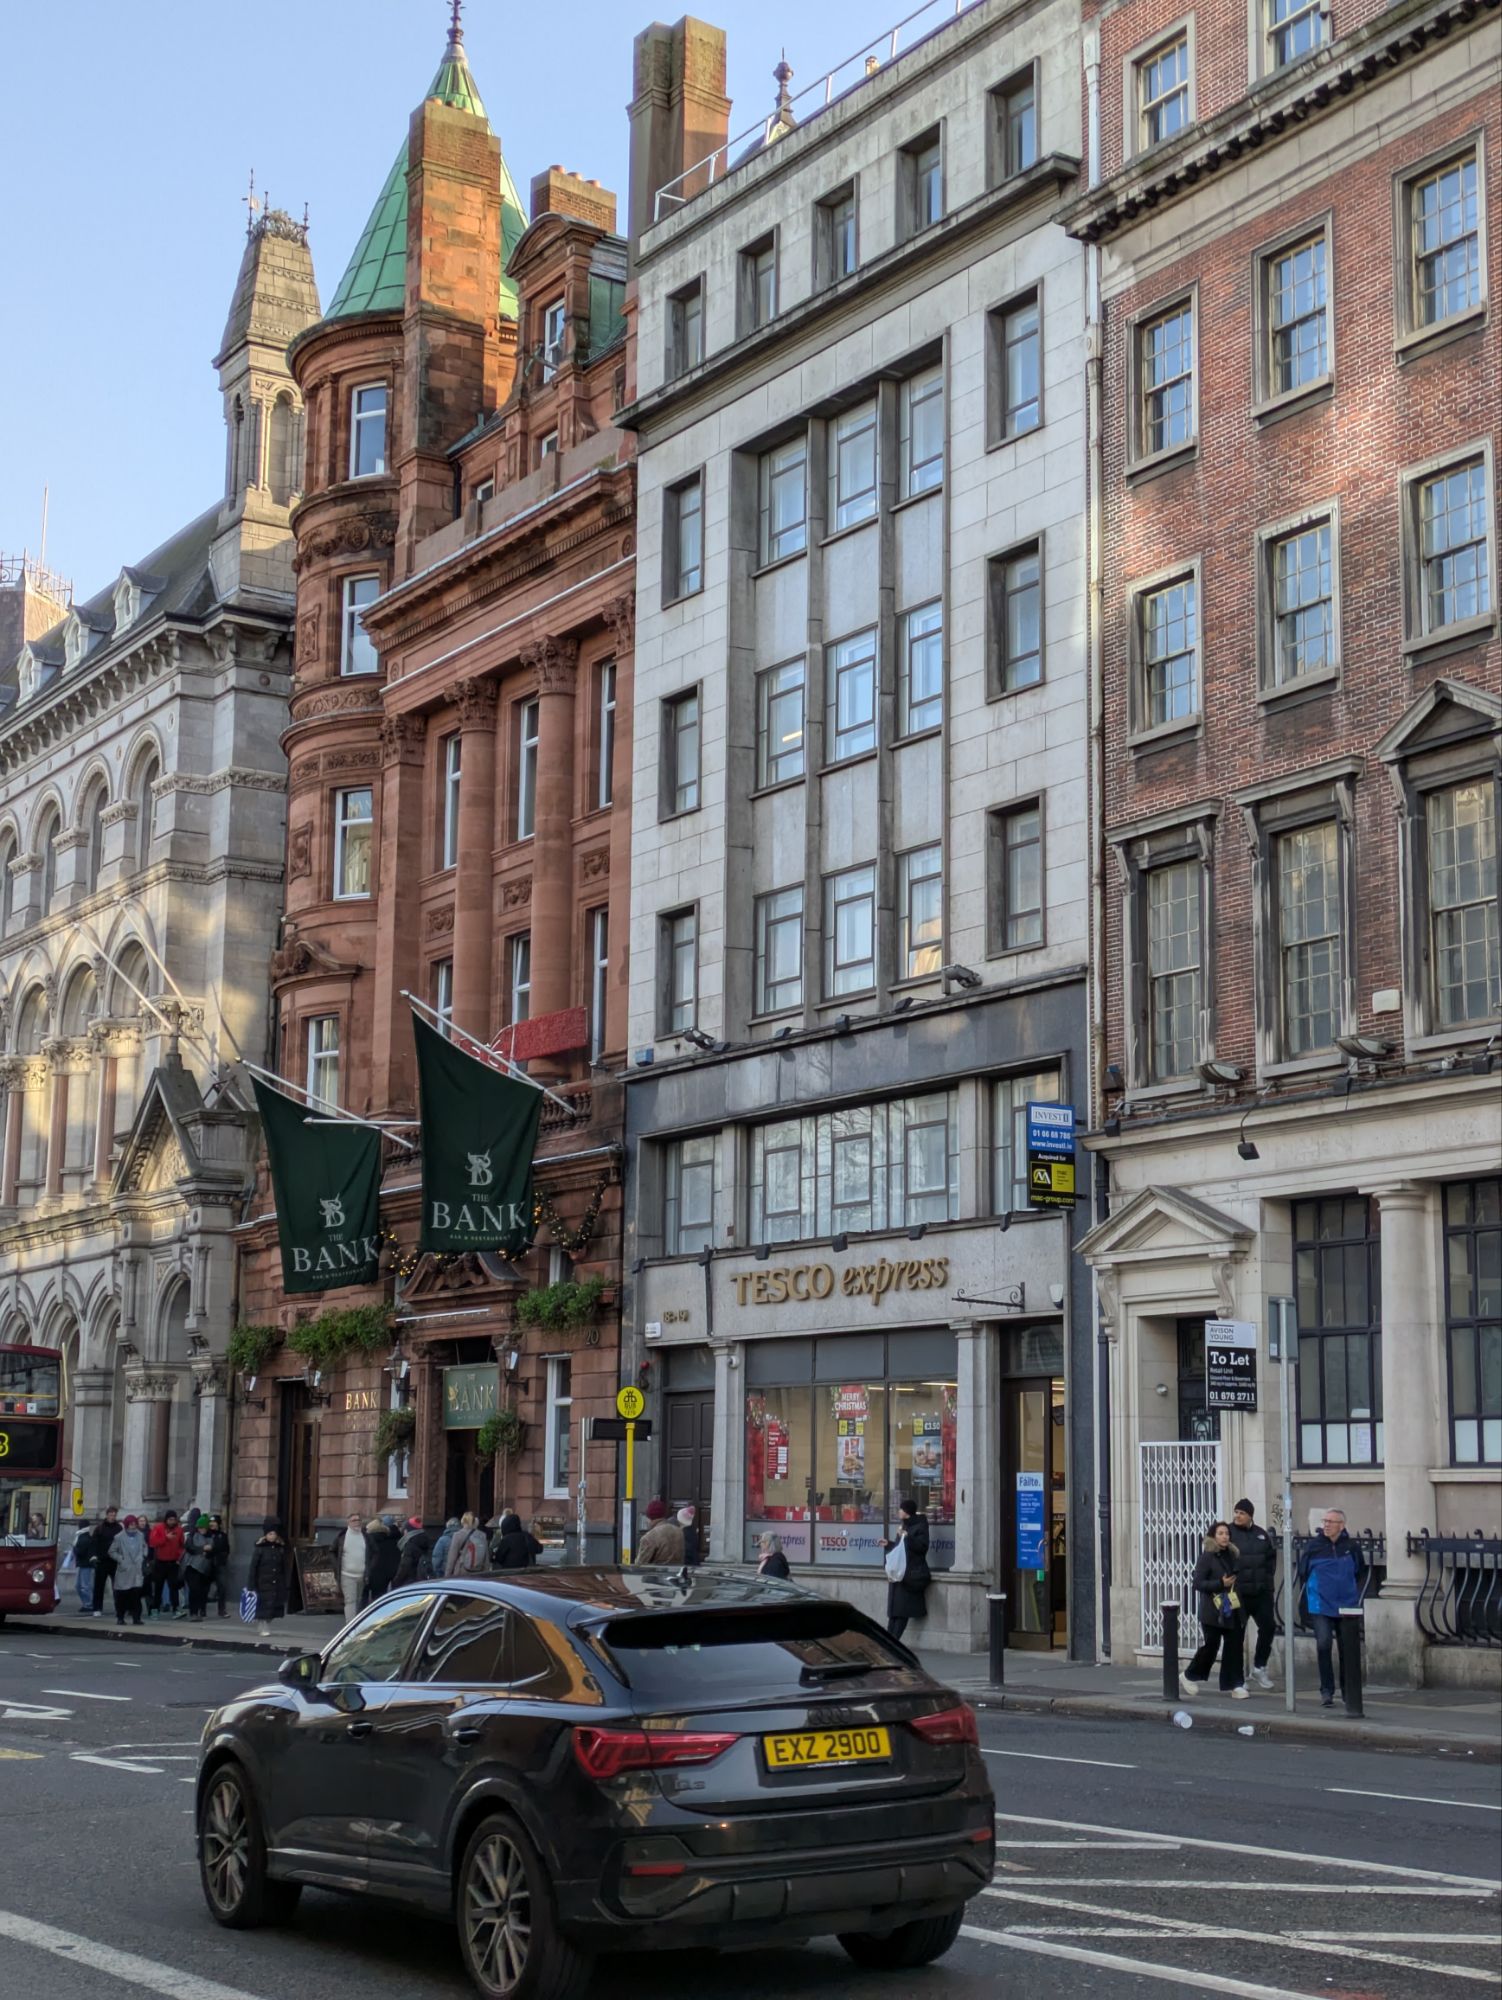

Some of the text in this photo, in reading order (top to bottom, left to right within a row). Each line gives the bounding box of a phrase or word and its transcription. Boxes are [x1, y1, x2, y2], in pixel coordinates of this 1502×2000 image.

[472, 1194, 489, 1202] THE
[431, 1201, 526, 1232] BANK
[328, 1233, 343, 1242] THE
[291, 1235, 379, 1272] BANK
[730, 1257, 949, 1306] TESCO express
[1210, 1351, 1250, 1366] To Let
[346, 1391, 377, 1410] BANK
[841, 1392, 859, 1401] MERRY
[1209, 1391, 1218, 1400] 01
[1237, 1392, 1255, 1401] 2711
[834, 1401, 866, 1411] CHRISTMAS
[821, 1536, 847, 1547] TESCO
[774, 1731, 880, 1762] EXZ 2900
